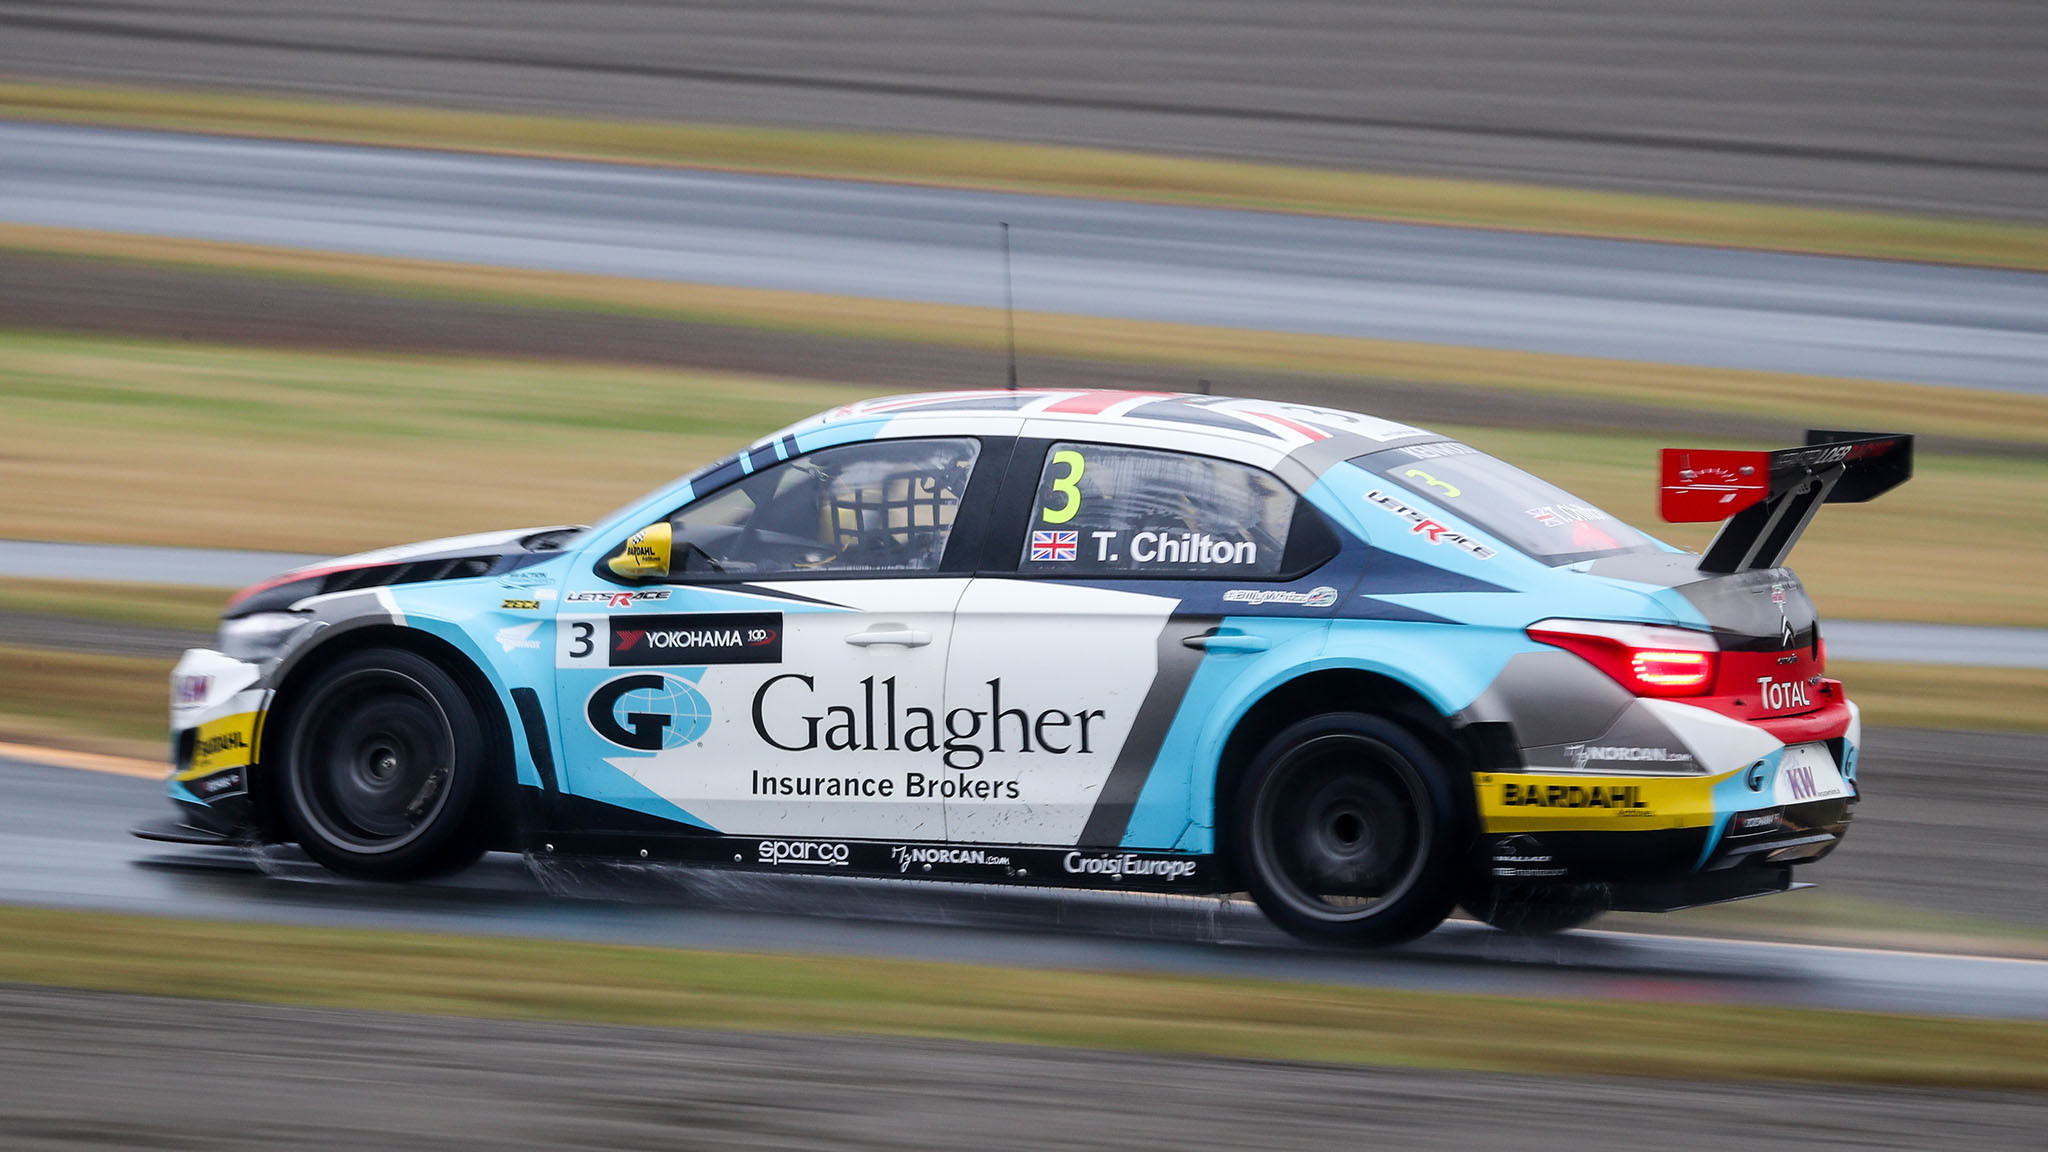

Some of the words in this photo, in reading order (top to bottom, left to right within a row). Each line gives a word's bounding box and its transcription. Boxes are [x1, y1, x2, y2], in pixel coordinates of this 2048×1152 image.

[1042, 449, 1086, 524] 3
[1405, 468, 1462, 498] 3
[1091, 531, 1119, 562] T.
[1130, 531, 1257, 565] Chilton
[569, 621, 596, 659] 3
[645, 630, 743, 648] YOKOHAMA
[750, 673, 1106, 770] Gallagher
[751, 770, 895, 797] Insurance
[906, 772, 1020, 799] Brokers
[1502, 783, 1649, 809] BARDAHL
[1786, 766, 1817, 800] KW
[758, 841, 849, 866] sparco
[1063, 851, 1197, 881] CroisiEurope
